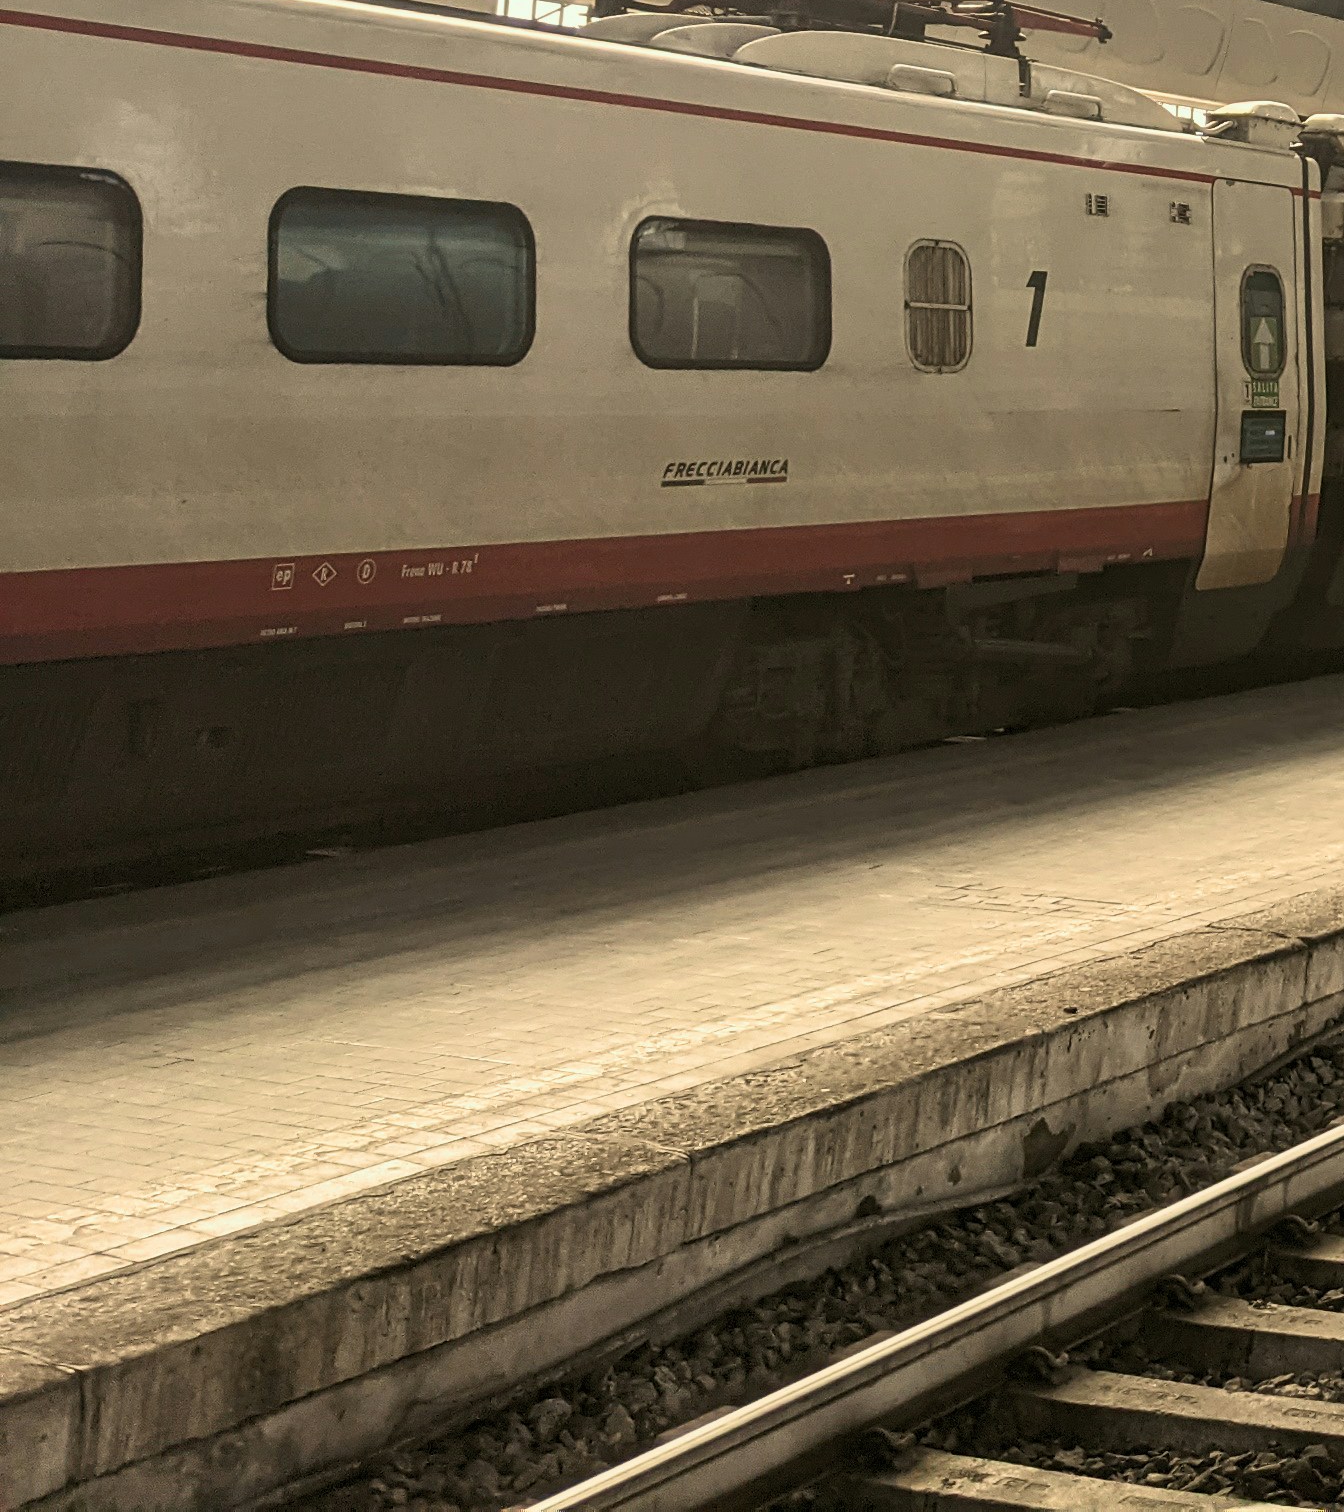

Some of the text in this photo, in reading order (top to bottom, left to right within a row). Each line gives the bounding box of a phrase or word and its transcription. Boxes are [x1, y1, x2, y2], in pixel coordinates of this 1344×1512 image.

[1026, 271, 1048, 347] 1
[662, 458, 790, 479] FRECCIABIANCA
[275, 568, 292, 586] ep
[320, 567, 329, 581] R
[362, 563, 371, 575] D
